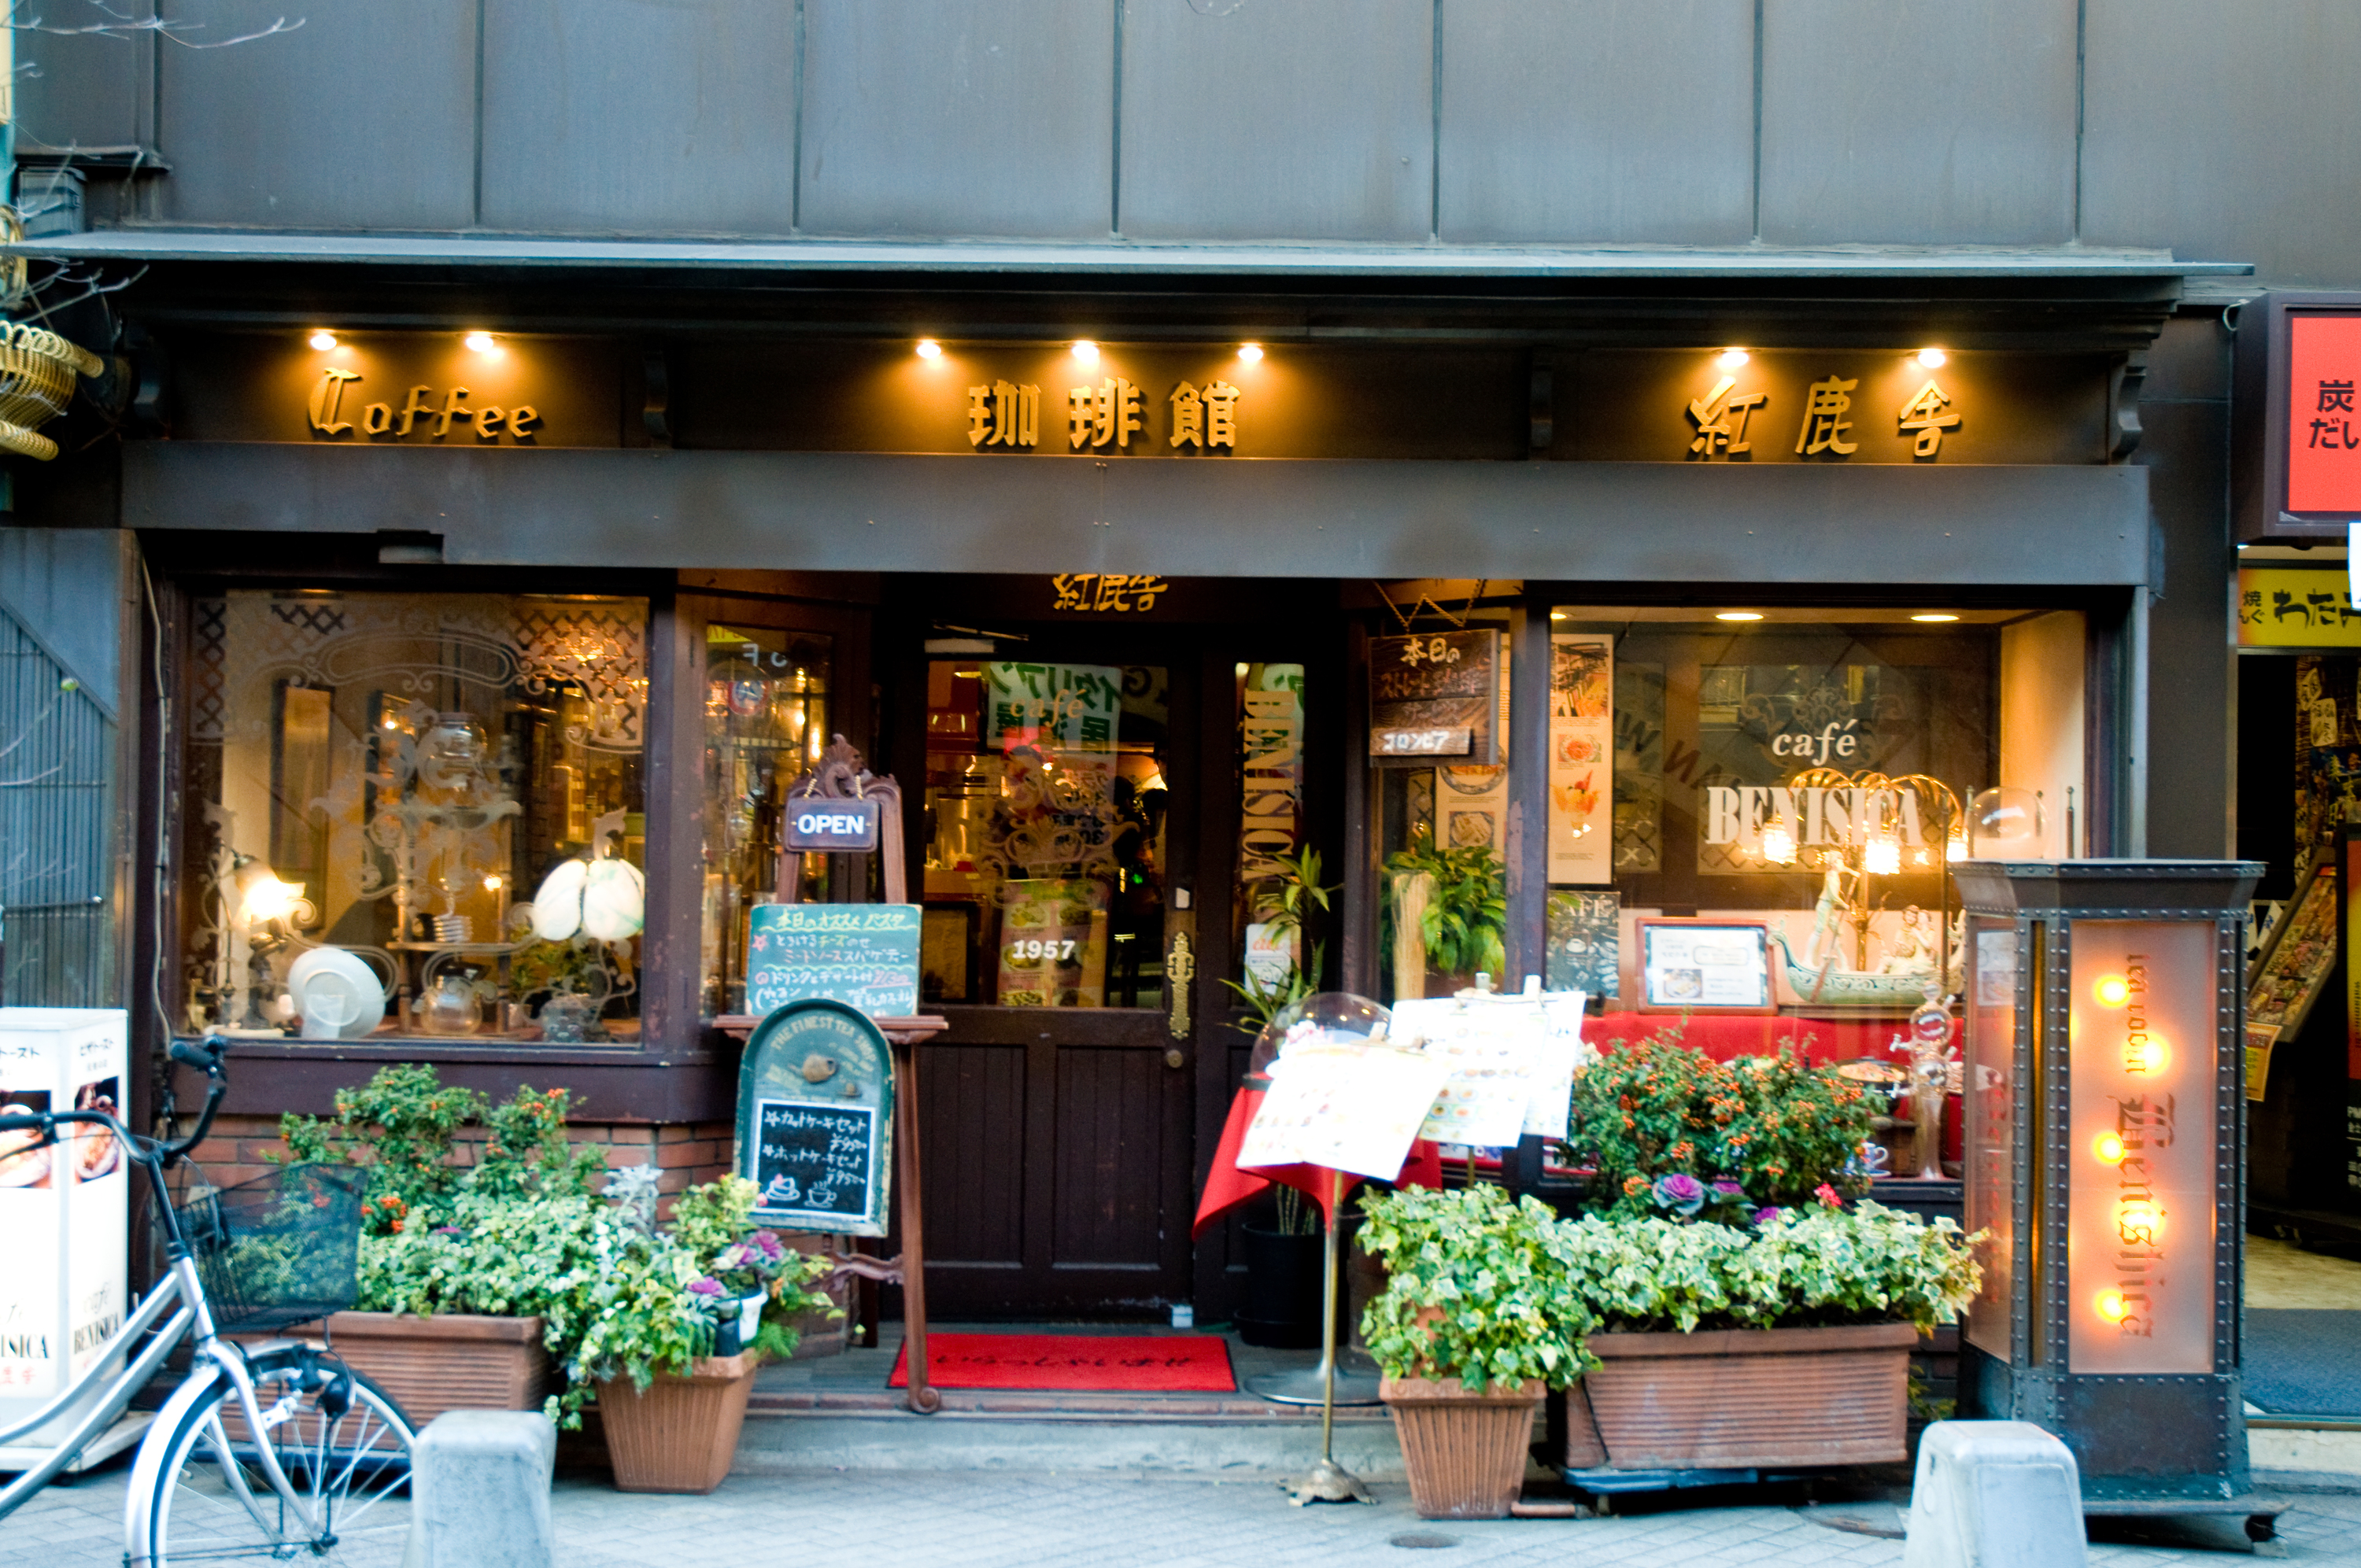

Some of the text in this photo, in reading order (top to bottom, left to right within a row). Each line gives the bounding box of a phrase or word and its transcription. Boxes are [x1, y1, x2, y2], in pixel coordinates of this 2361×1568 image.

[308, 367, 540, 438] Coffee
[967, 376, 1241, 449] 珈琲館
[1690, 374, 1961, 457] 紅鹿舎
[1010, 688, 1087, 728] café
[1772, 719, 1858, 766] café
[797, 814, 865, 835] OPEN
[1705, 786, 1923, 847] BENISICA
[1013, 939, 1076, 961] 1957
[790, 1016, 834, 1034] FINEST
[835, 1020, 855, 1038] TEA
